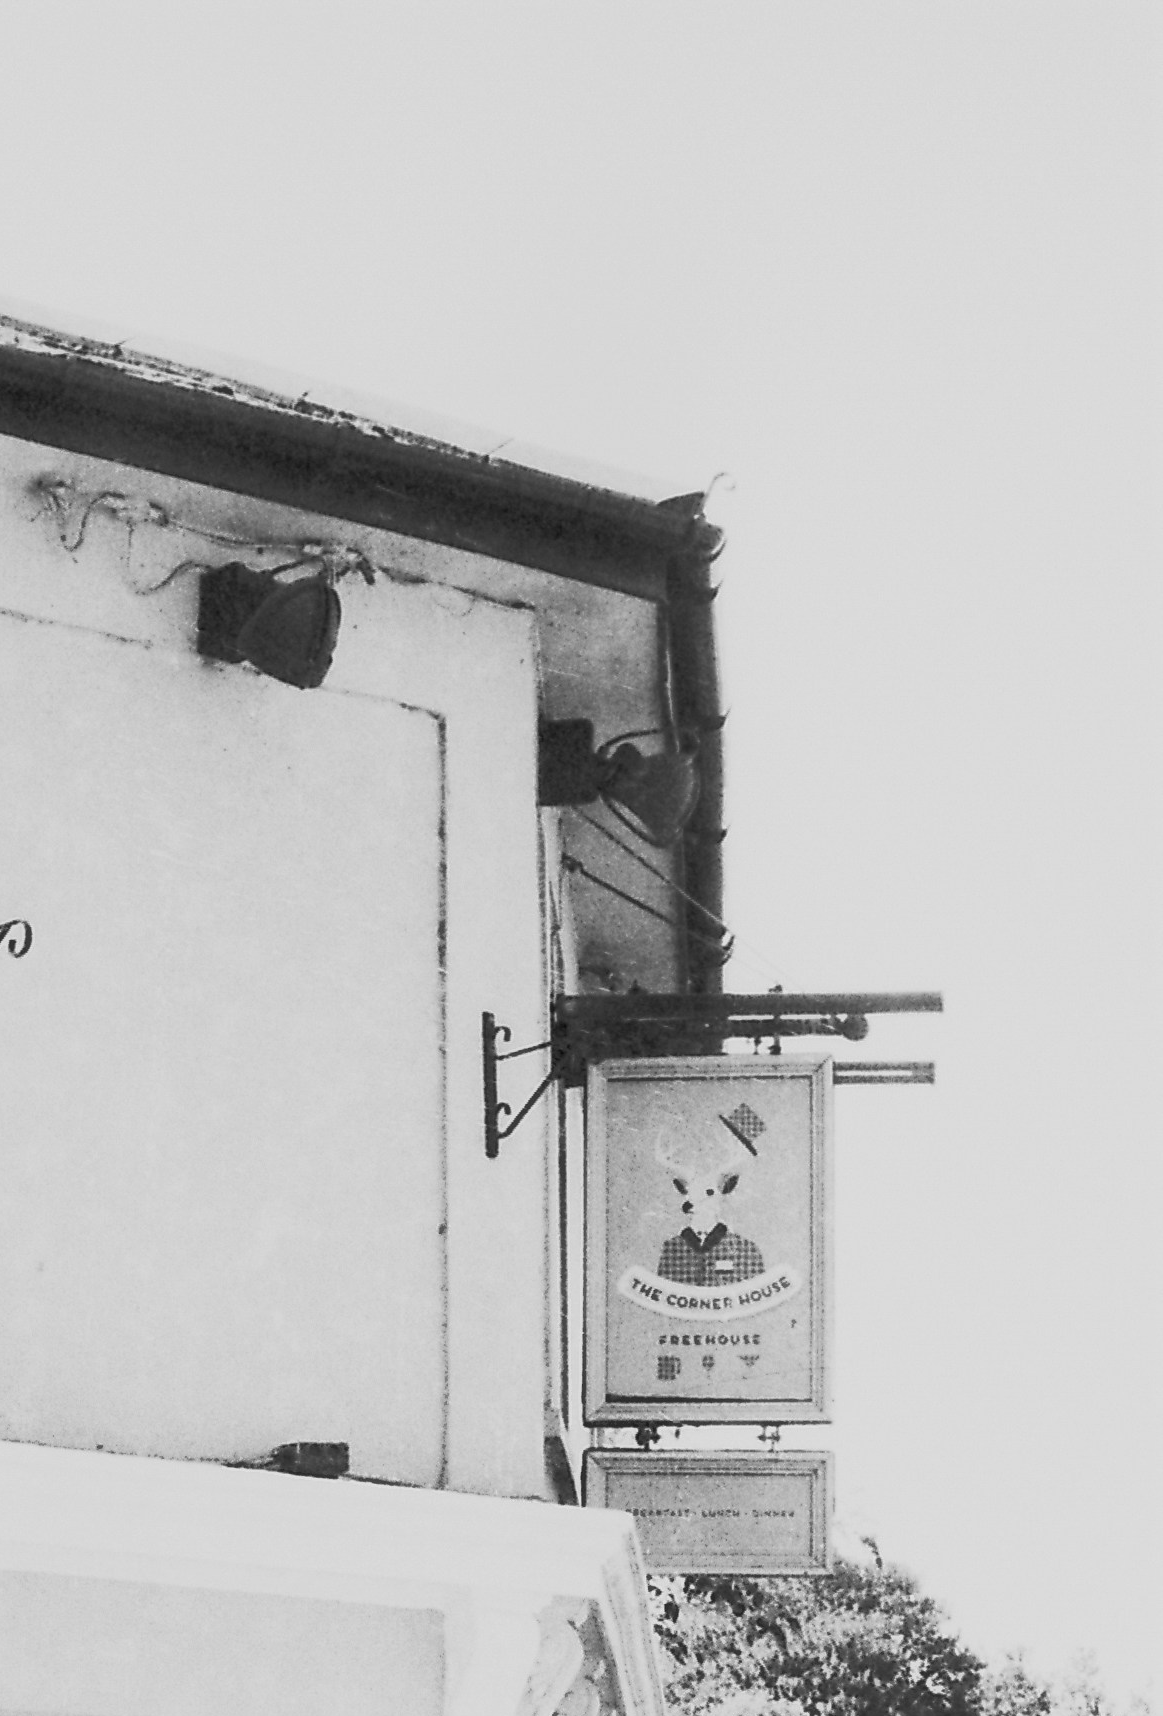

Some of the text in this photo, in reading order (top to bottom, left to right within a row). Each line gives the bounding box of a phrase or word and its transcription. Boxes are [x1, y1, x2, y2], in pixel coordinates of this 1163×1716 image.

[632, 1276, 791, 1310] THE CORNER HOUSE
[658, 1333, 762, 1346] FREEHOUSE
